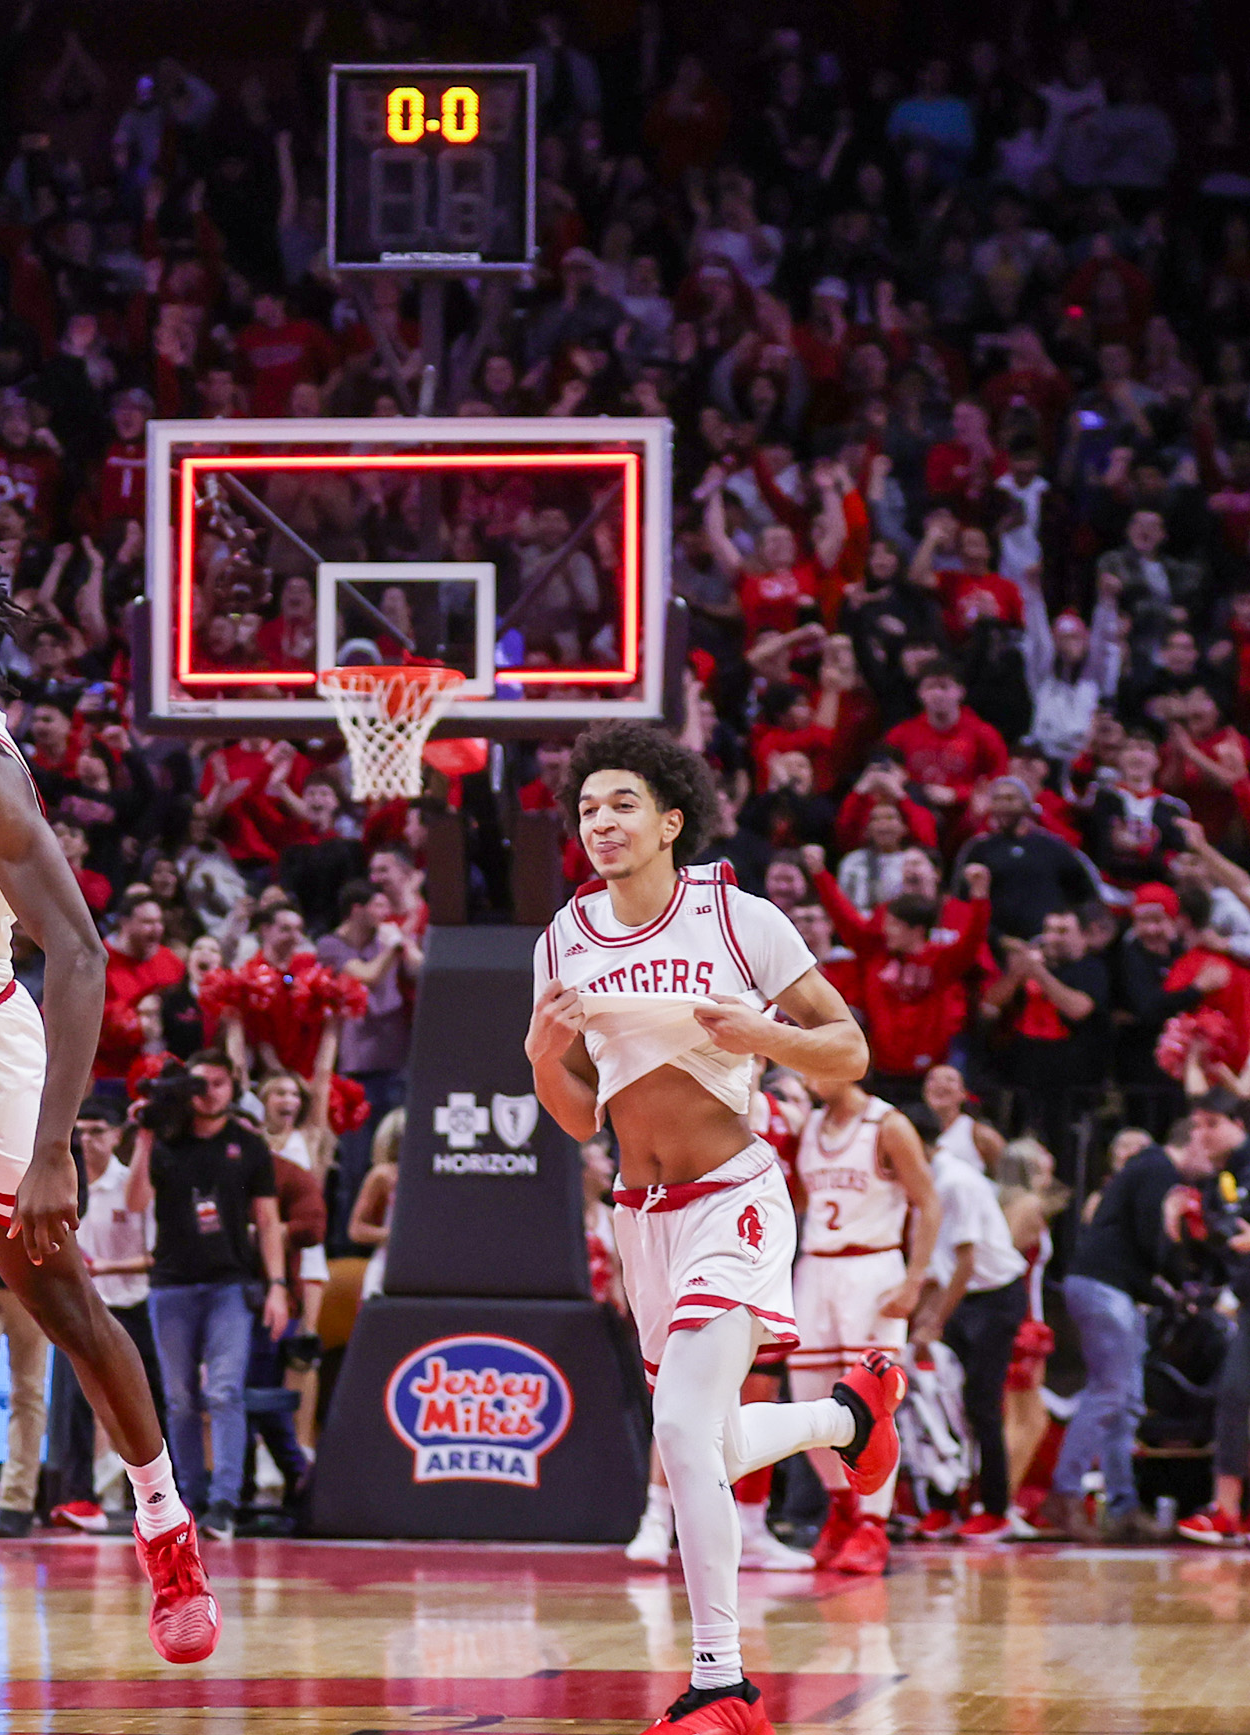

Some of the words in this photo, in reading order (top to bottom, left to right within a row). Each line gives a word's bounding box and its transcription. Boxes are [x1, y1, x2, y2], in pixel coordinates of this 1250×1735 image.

[387, 86, 480, 143] 0.0
[433, 1153, 538, 1175] HORIZON
[825, 1201, 842, 1231] 2
[414, 1361, 544, 1410] Jersey
[421, 1399, 538, 1436] Mike's
[424, 1450, 528, 1478] ARENA
